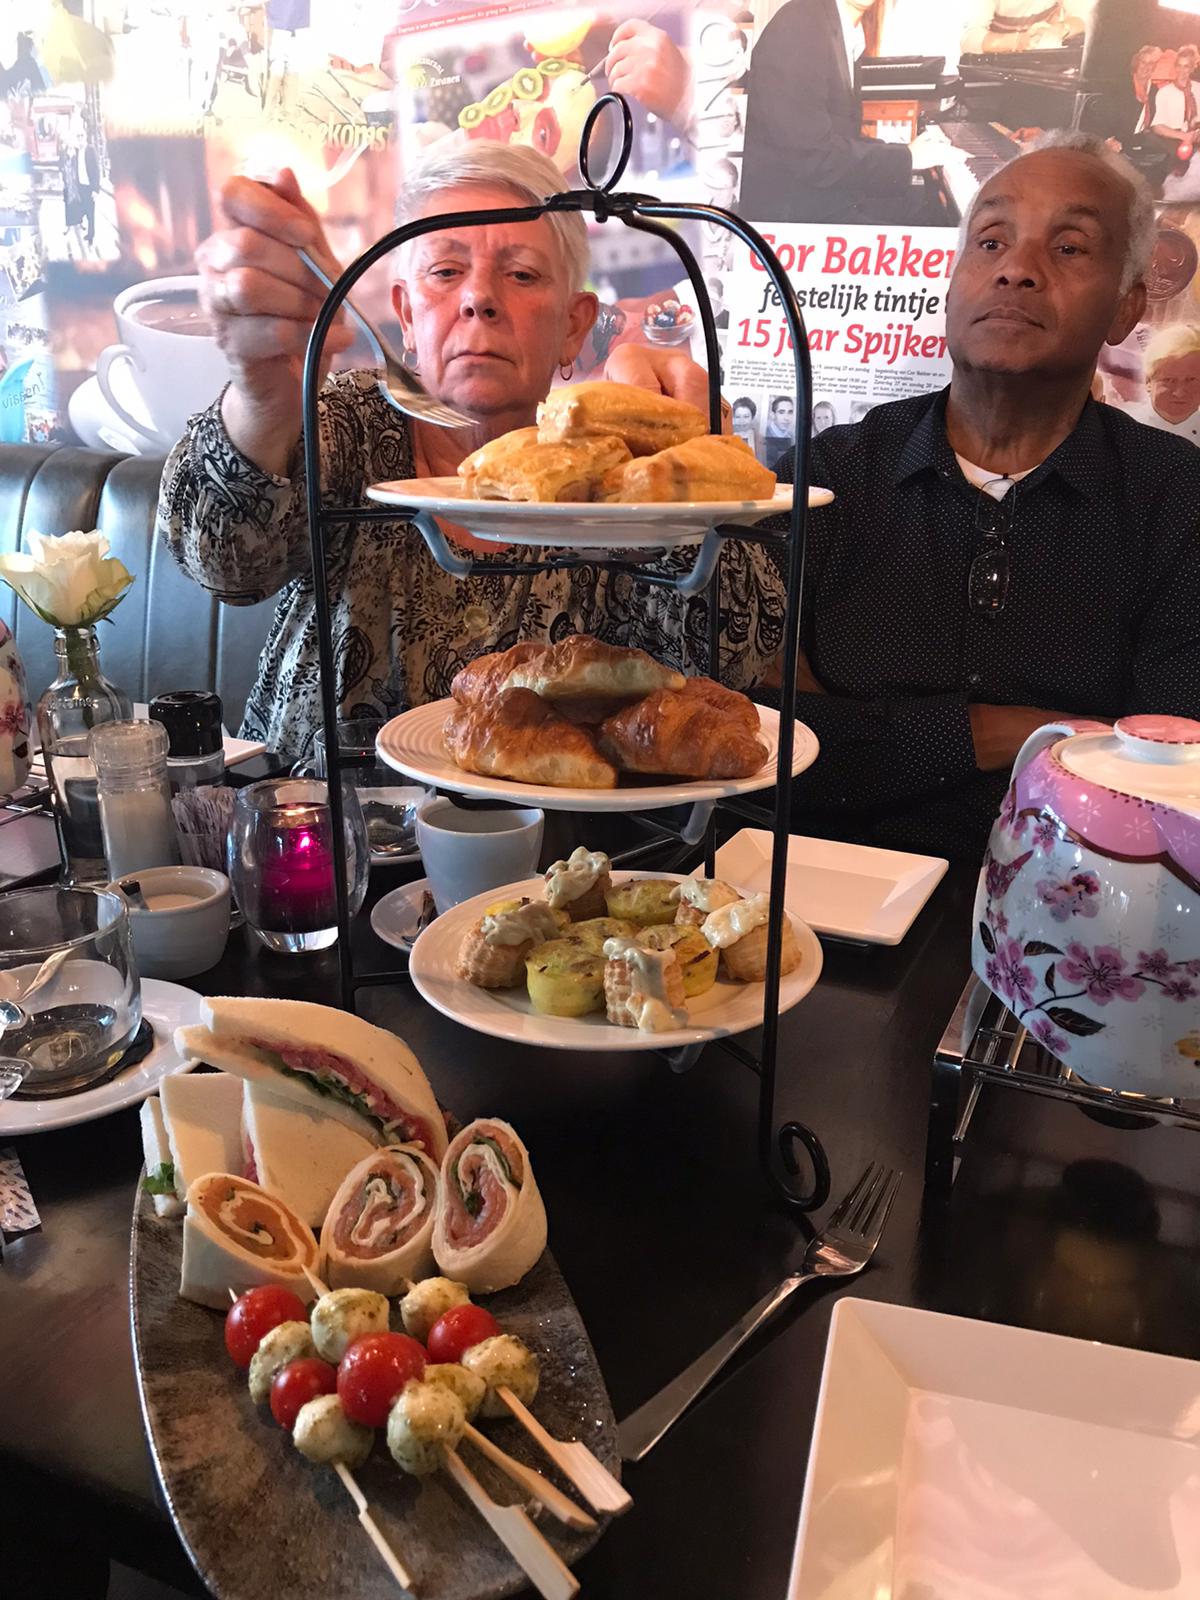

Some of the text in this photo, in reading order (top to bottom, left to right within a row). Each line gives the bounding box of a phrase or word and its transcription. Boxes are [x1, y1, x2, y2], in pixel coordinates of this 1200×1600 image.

[758, 281, 869, 317] festelijk
[874, 286, 940, 321] tintje
[738, 318, 771, 347] 15
